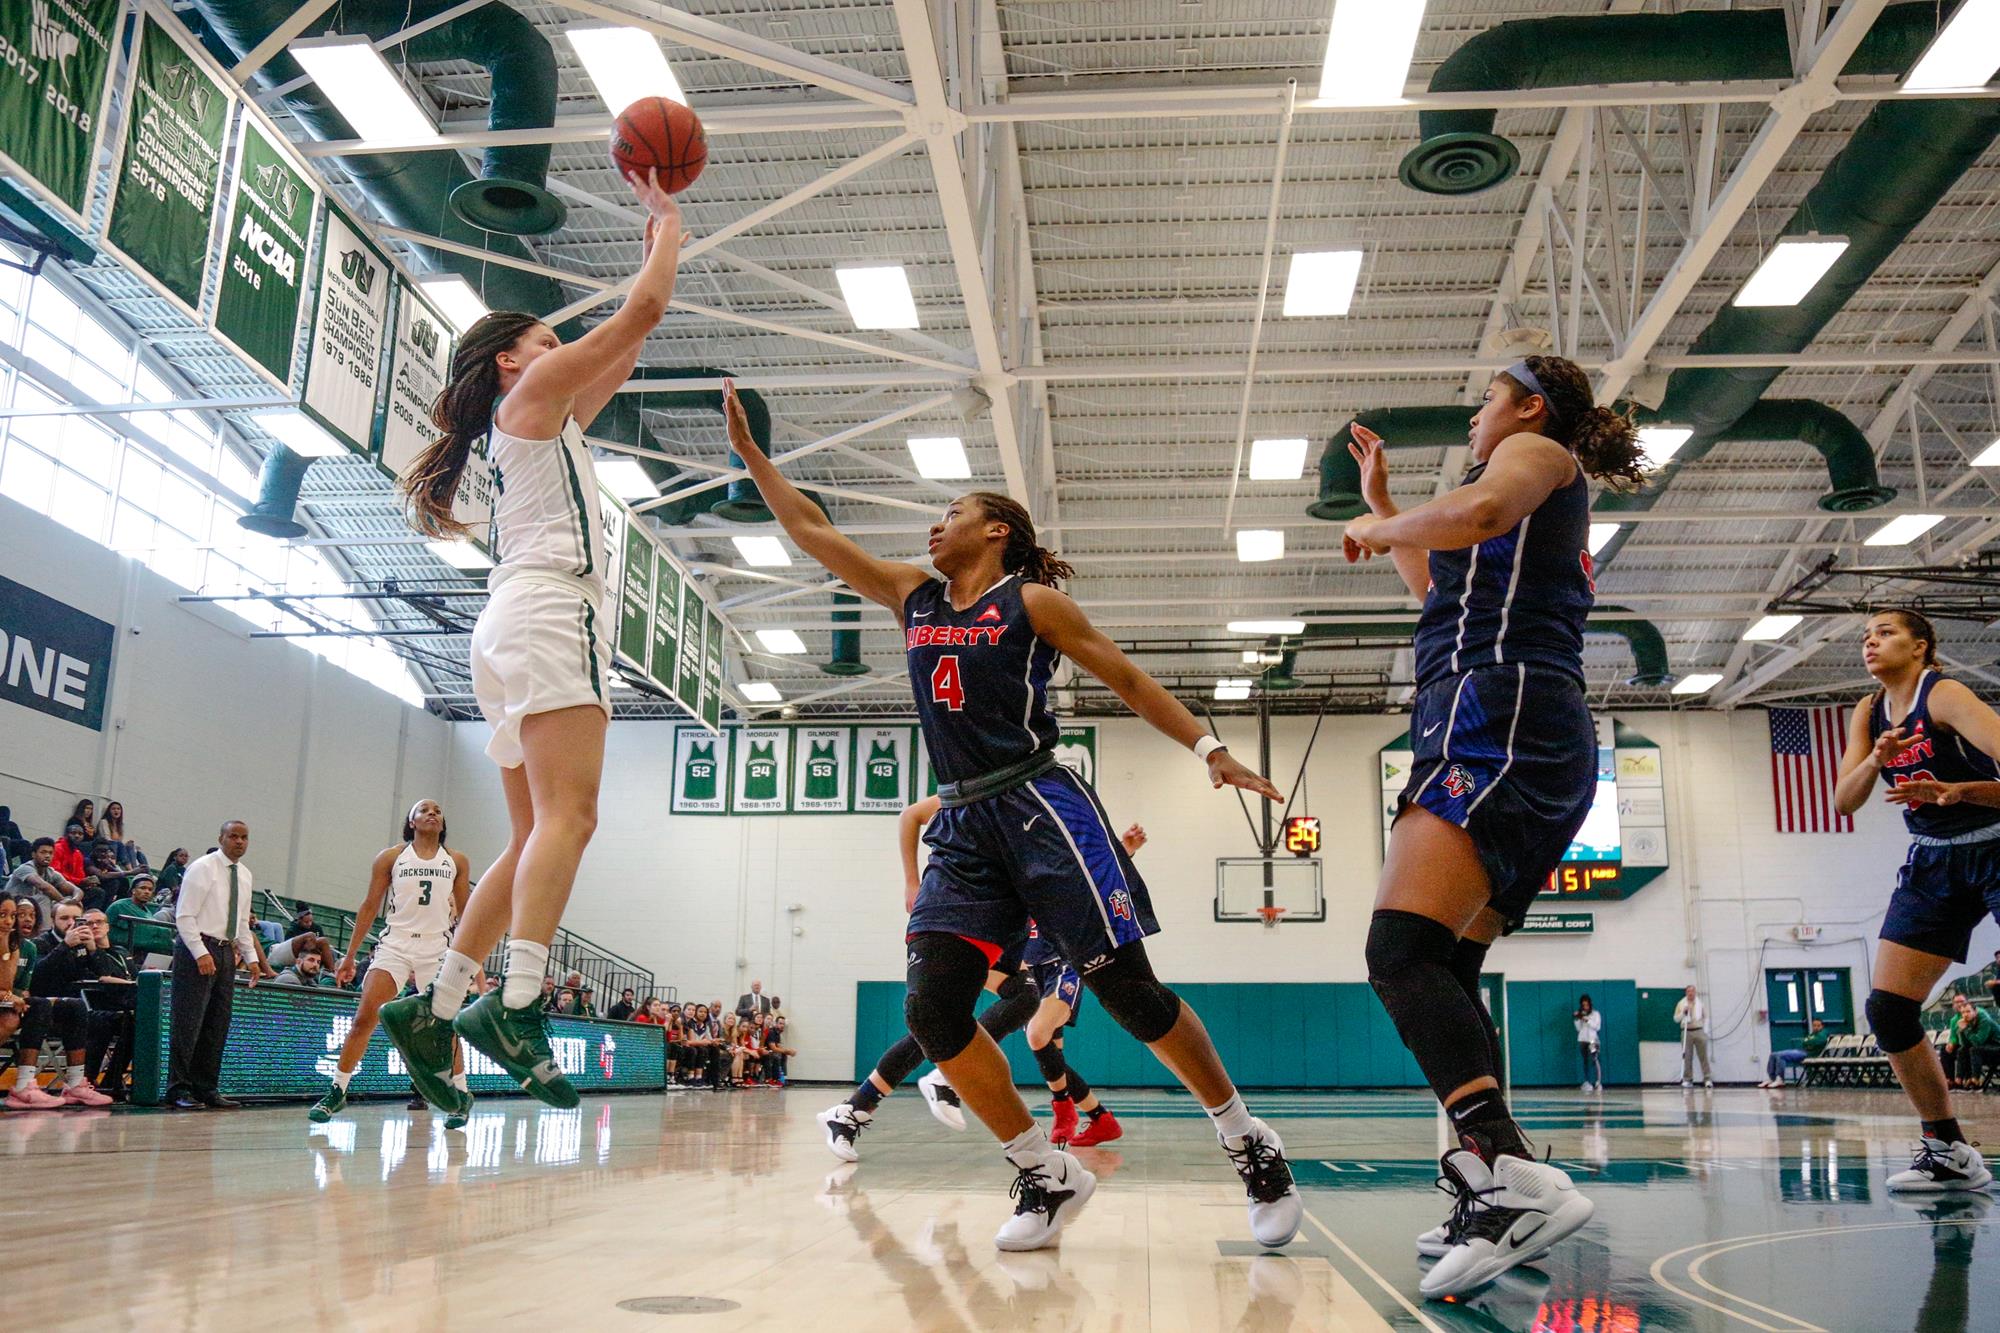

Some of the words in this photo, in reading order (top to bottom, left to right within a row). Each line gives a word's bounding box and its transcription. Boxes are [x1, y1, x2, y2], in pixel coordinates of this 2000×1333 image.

[0, 34, 39, 85] 2017
[46, 83, 91, 133] 2018
[138, 76, 176, 119] WOMEN'S
[175, 113, 219, 163] BASKETBALL
[131, 160, 167, 202] 2016
[136, 140, 206, 213] CHAMPIONS
[139, 125, 208, 197] TOURNAMENT
[239, 213, 296, 288] NCAA
[269, 211, 305, 252] BASKETBALL
[233, 254, 262, 291] 2016
[327, 268, 346, 291] MEN'S
[346, 286, 380, 324] BASKETBALL
[327, 286, 350, 320] SUN
[351, 308, 375, 342] BELT
[323, 318, 374, 371] CHAMPIONS
[324, 303, 375, 357] TOURNAMENT
[322, 336, 345, 366] 1979
[348, 360, 373, 388] 1986
[399, 361, 433, 402] ASU
[415, 352, 443, 386] BASKETBALL
[393, 400, 414, 426] 2009
[395, 378, 431, 418] CHAMPIO
[907, 624, 1009, 651] LIBERTY
[0, 627, 90, 711] NE
[931, 655, 966, 712] 4
[680, 731, 726, 739] STRICKLAD
[807, 730, 840, 738] GILMORE
[1059, 728, 1086, 736] ORTON
[691, 765, 711, 778] 52
[751, 765, 770, 778] 24
[812, 765, 832, 777] 53
[872, 765, 893, 777] 43
[1885, 738, 1935, 768] ERTY
[1289, 826, 1317, 850] 24
[398, 867, 452, 880] JACKSONVILLE
[418, 880, 432, 906] 3
[1523, 920, 1563, 928] EPHANIE
